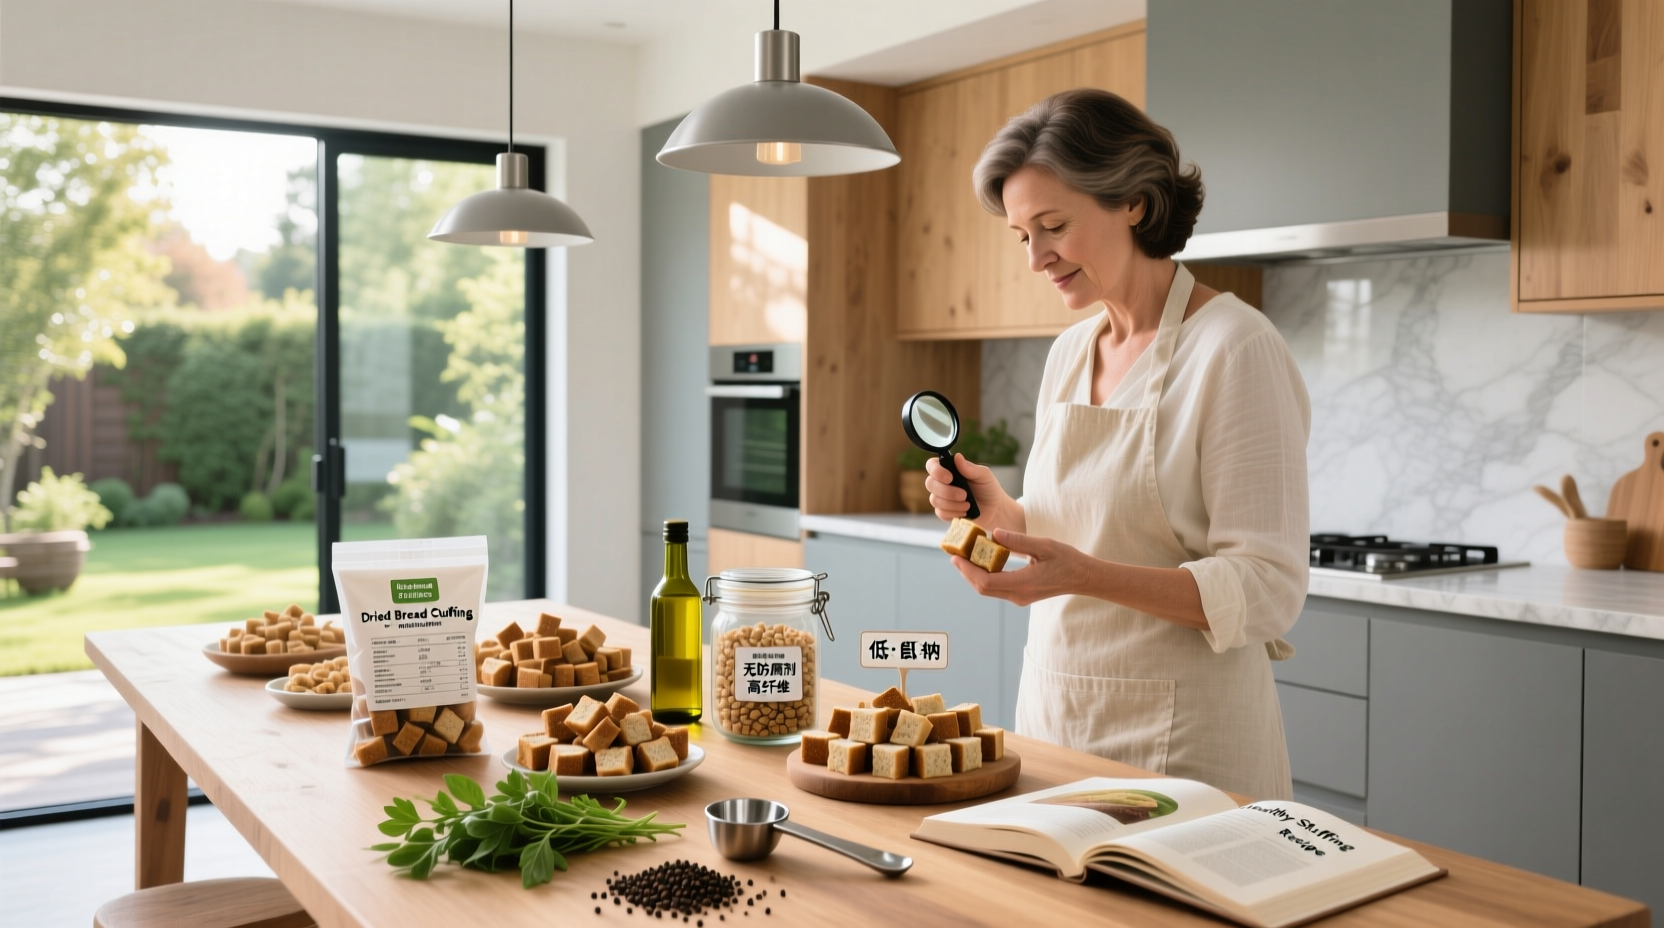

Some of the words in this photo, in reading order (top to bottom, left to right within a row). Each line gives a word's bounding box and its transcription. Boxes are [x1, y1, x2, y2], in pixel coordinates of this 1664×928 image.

[361, 610, 391, 623] Dried
[394, 607, 428, 621] Bread
[747, 679, 790, 695] 高纤维
